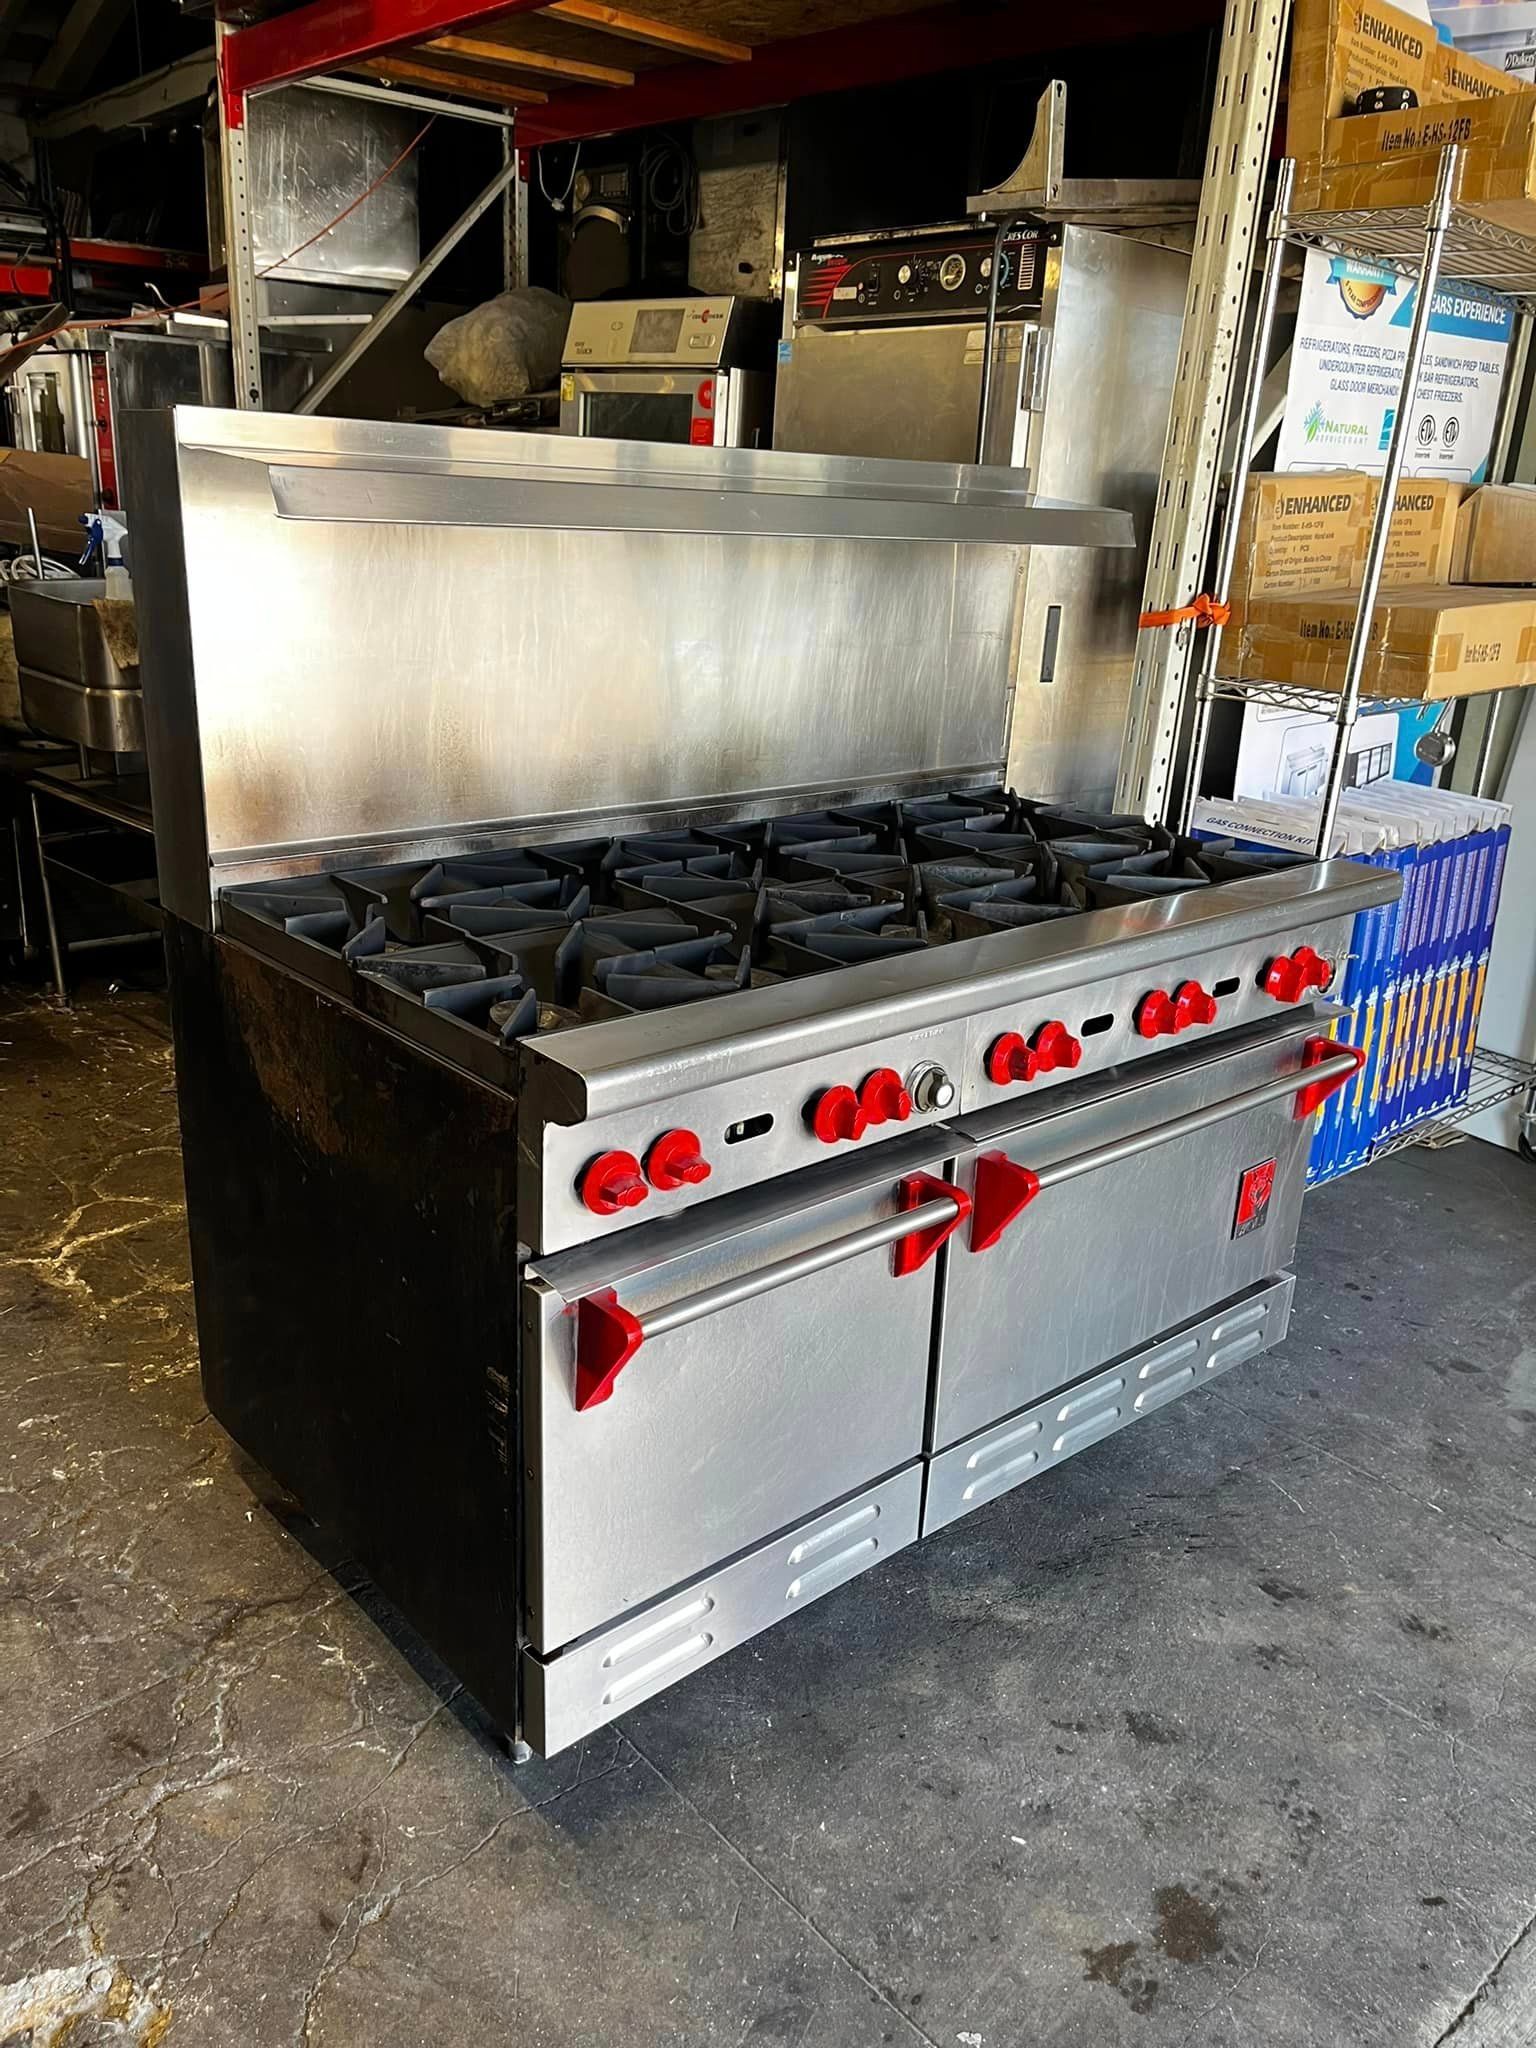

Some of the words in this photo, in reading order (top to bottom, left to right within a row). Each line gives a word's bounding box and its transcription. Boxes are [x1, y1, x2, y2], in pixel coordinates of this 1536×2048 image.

[1363, 13, 1423, 60] ENHANCED
[1381, 128, 1402, 153] Item
[1453, 298, 1507, 325] EXPERIENCE
[1319, 359, 1367, 375] UNDERCOUNTER
[1329, 378, 1350, 392] GLASS
[1350, 380, 1366, 393] DOOR
[1416, 388, 1433, 400] CHEST
[1285, 494, 1351, 516] ENHANCED
[1300, 619, 1318, 639] Item
[1206, 816, 1228, 827] GAS
[1227, 822, 1296, 841] CONNECTION
[1295, 836, 1315, 845] KIT
